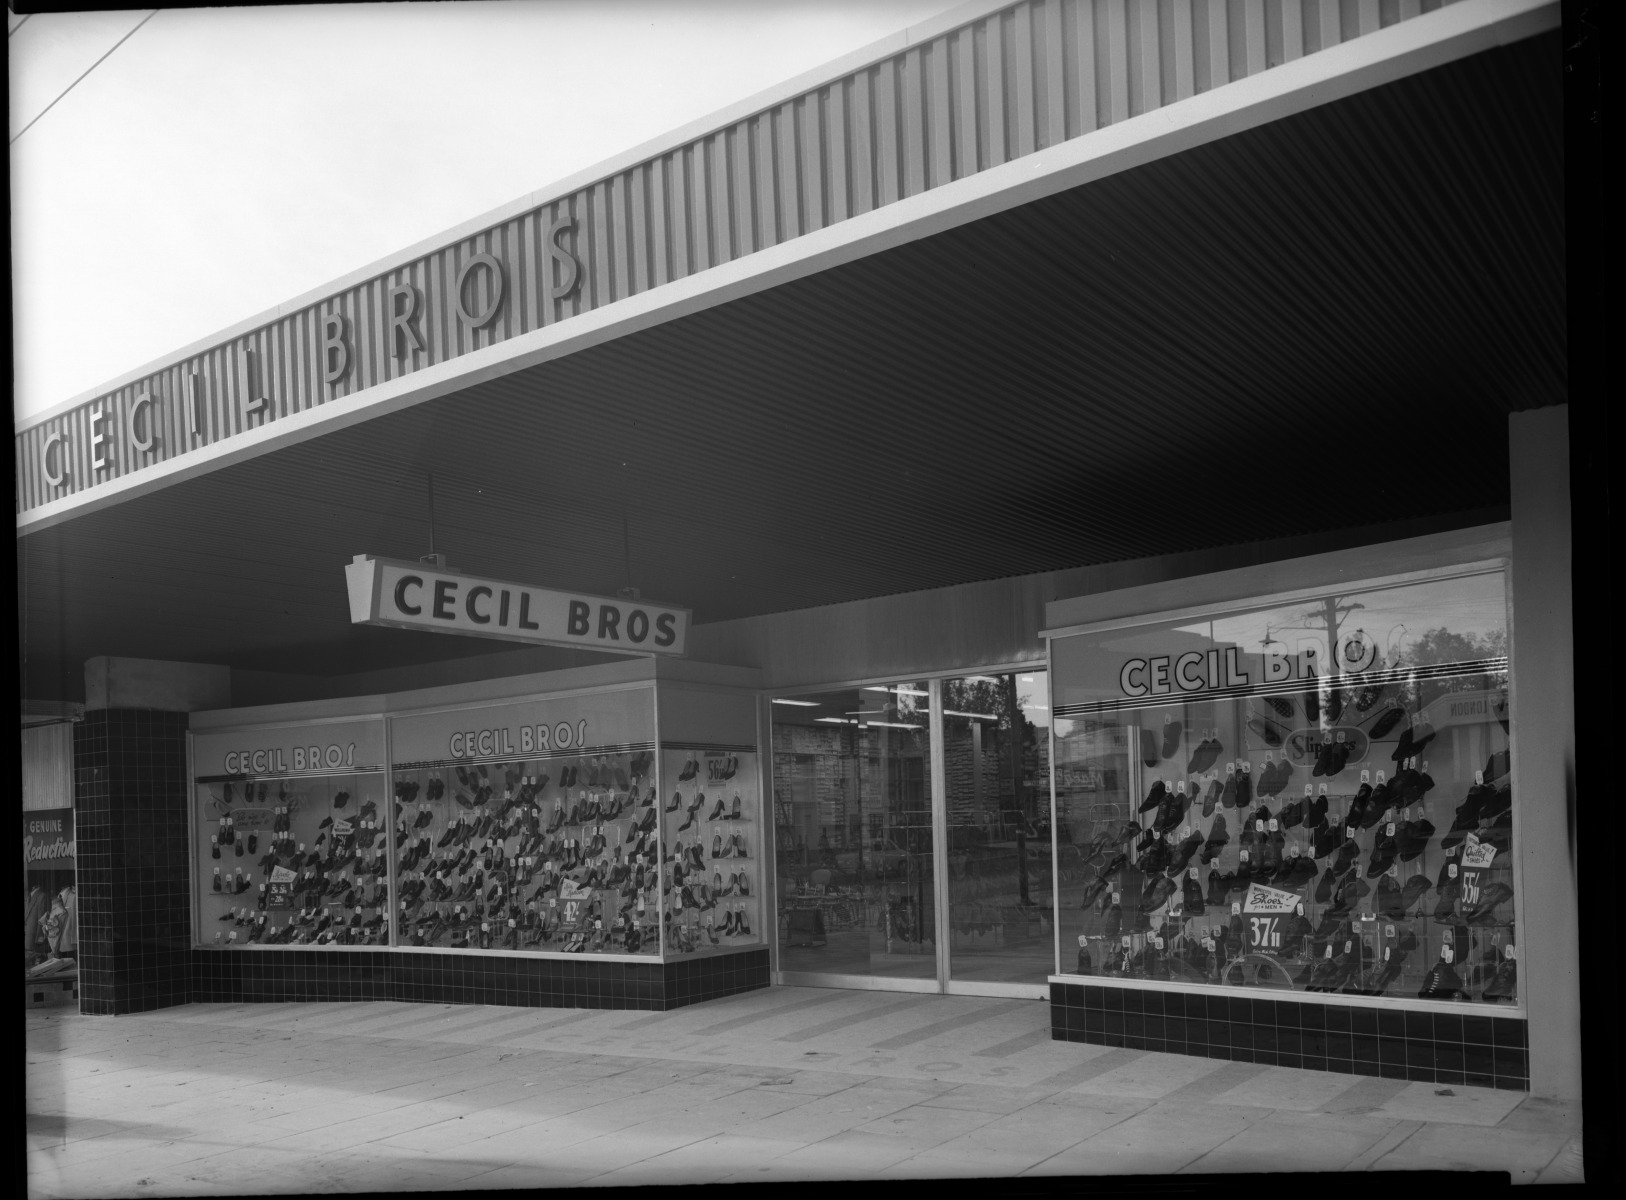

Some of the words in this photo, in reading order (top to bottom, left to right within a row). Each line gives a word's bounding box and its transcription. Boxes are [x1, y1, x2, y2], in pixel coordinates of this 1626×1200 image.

[42, 349, 266, 487] CECIL
[322, 215, 580, 384] BROS
[394, 574, 540, 631] CECIL
[567, 599, 677, 647] BROS
[1119, 646, 1249, 698] CECIL
[1262, 624, 1408, 684] BROS
[449, 728, 515, 759] CECIL
[520, 719, 588, 753] BROS
[224, 749, 288, 775] CECIL
[293, 742, 357, 771] BROS
[29, 819, 63, 833] GENUINE
[23, 835, 75, 863] Reduction
[1250, 893, 1284, 905] Shoes
[1250, 917, 1281, 948] 37/11
